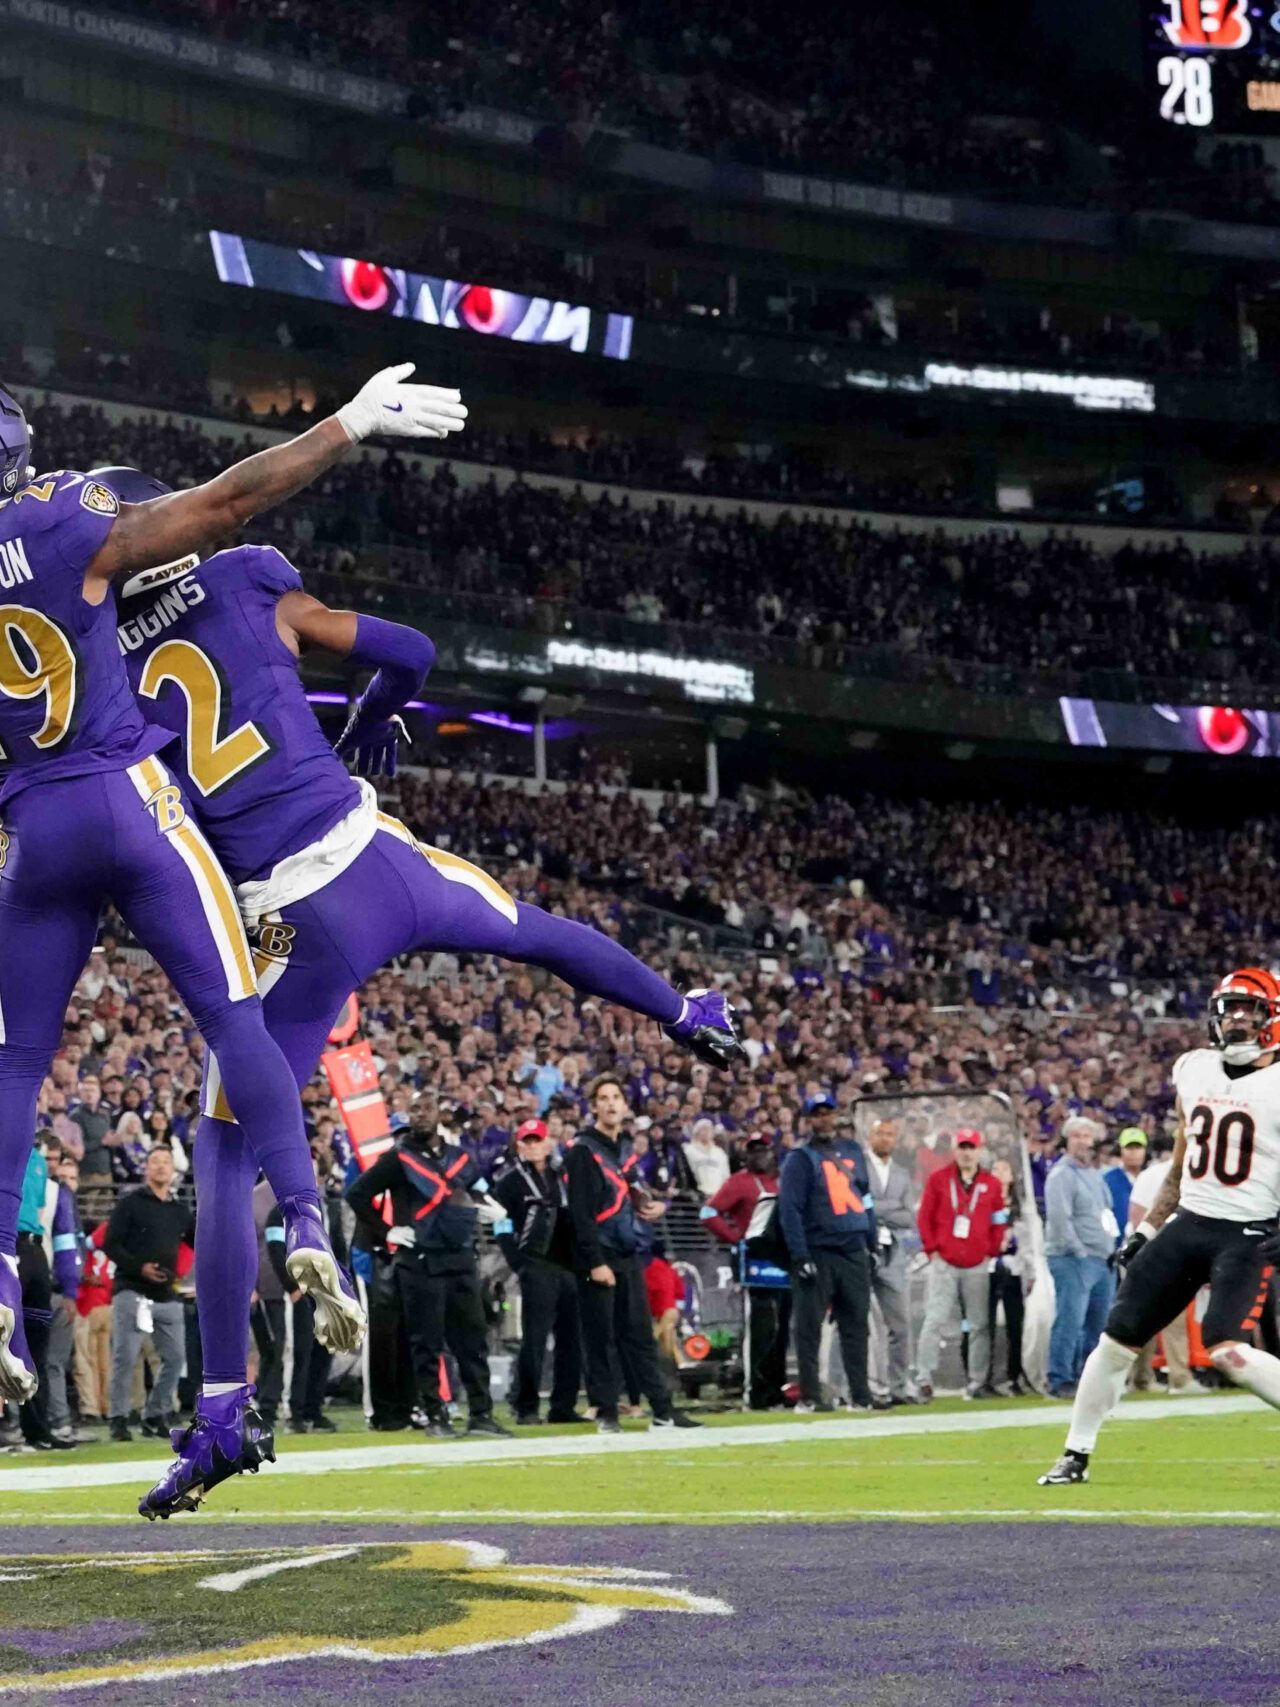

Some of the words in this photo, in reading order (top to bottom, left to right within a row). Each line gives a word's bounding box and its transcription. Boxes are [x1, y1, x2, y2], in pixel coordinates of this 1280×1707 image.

[1157, 56, 1214, 126] 28
[139, 559, 195, 586] RAVENS
[138, 639, 271, 797] 2
[1188, 1104, 1256, 1188] 30
[822, 1158, 865, 1215] K
